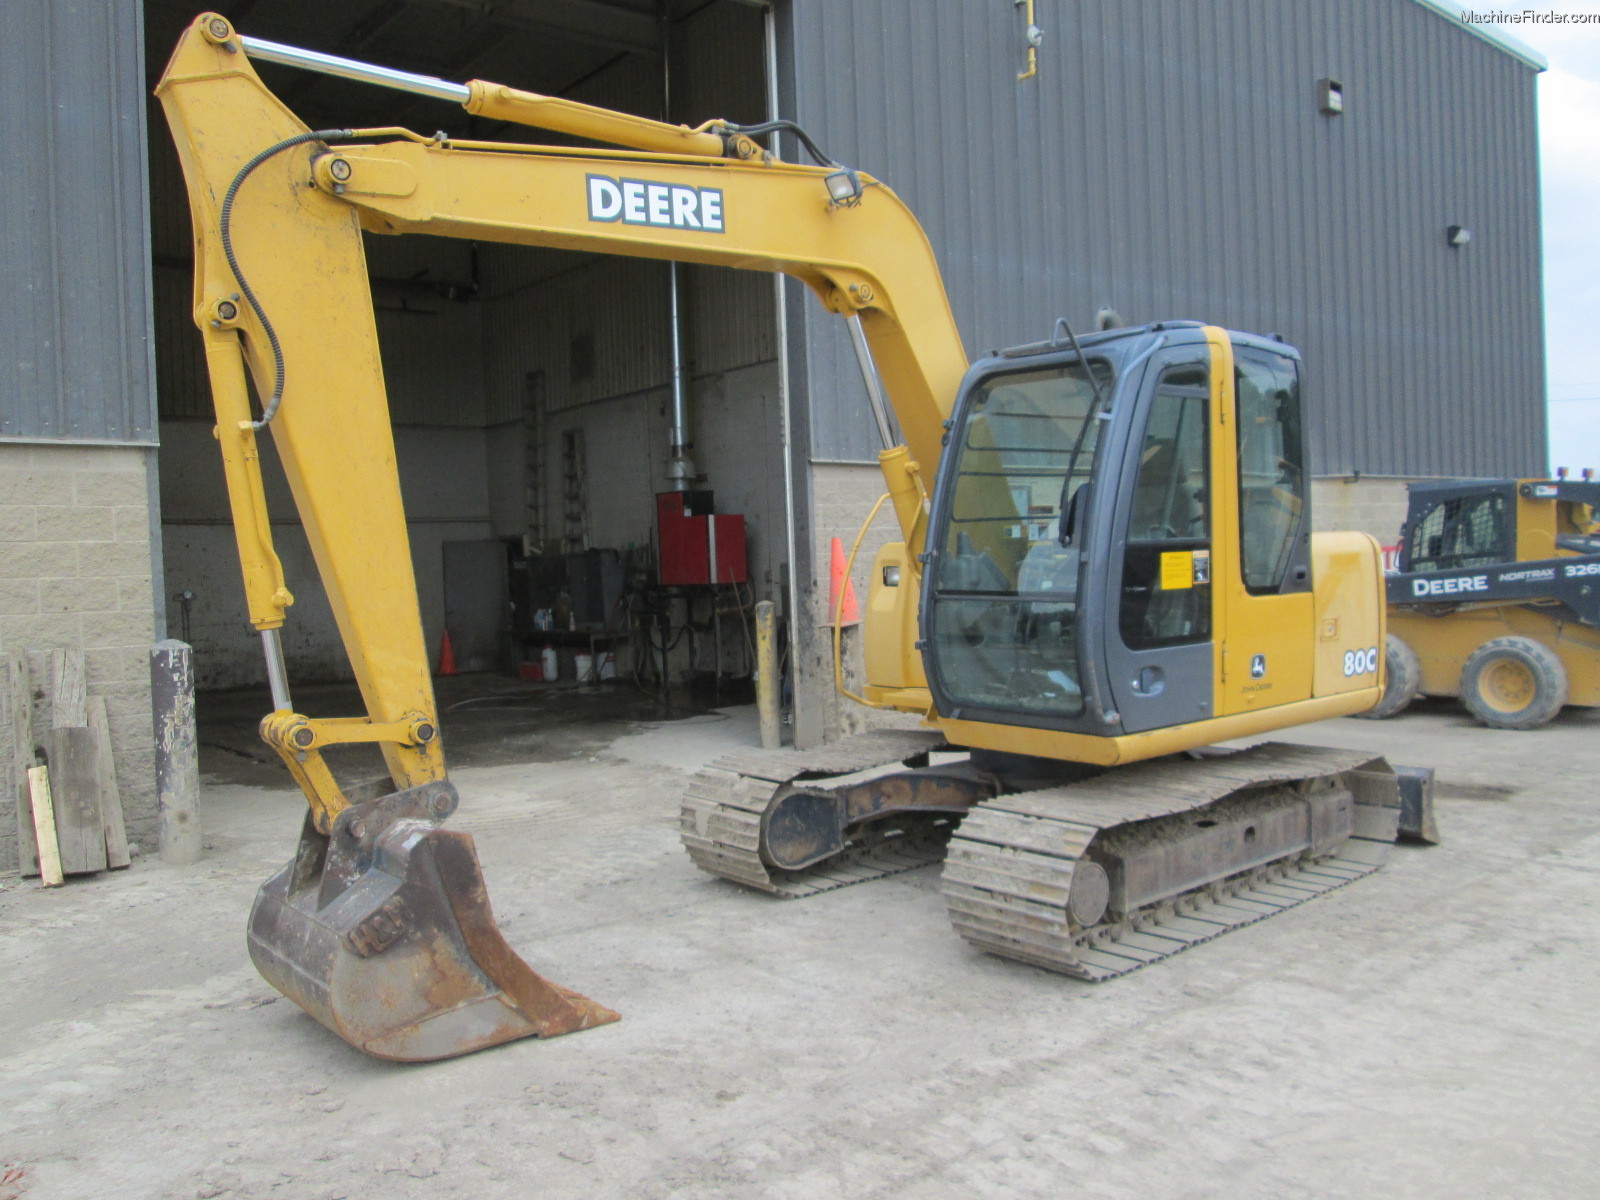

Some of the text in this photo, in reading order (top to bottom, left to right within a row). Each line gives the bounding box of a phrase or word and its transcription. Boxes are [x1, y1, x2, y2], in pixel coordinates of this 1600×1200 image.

[589, 177, 723, 230] DEERE
[1499, 568, 1555, 581] NORTRAX
[1564, 563, 1600, 578] 326
[1412, 575, 1489, 597] DEERE
[1344, 647, 1377, 677] 80C
